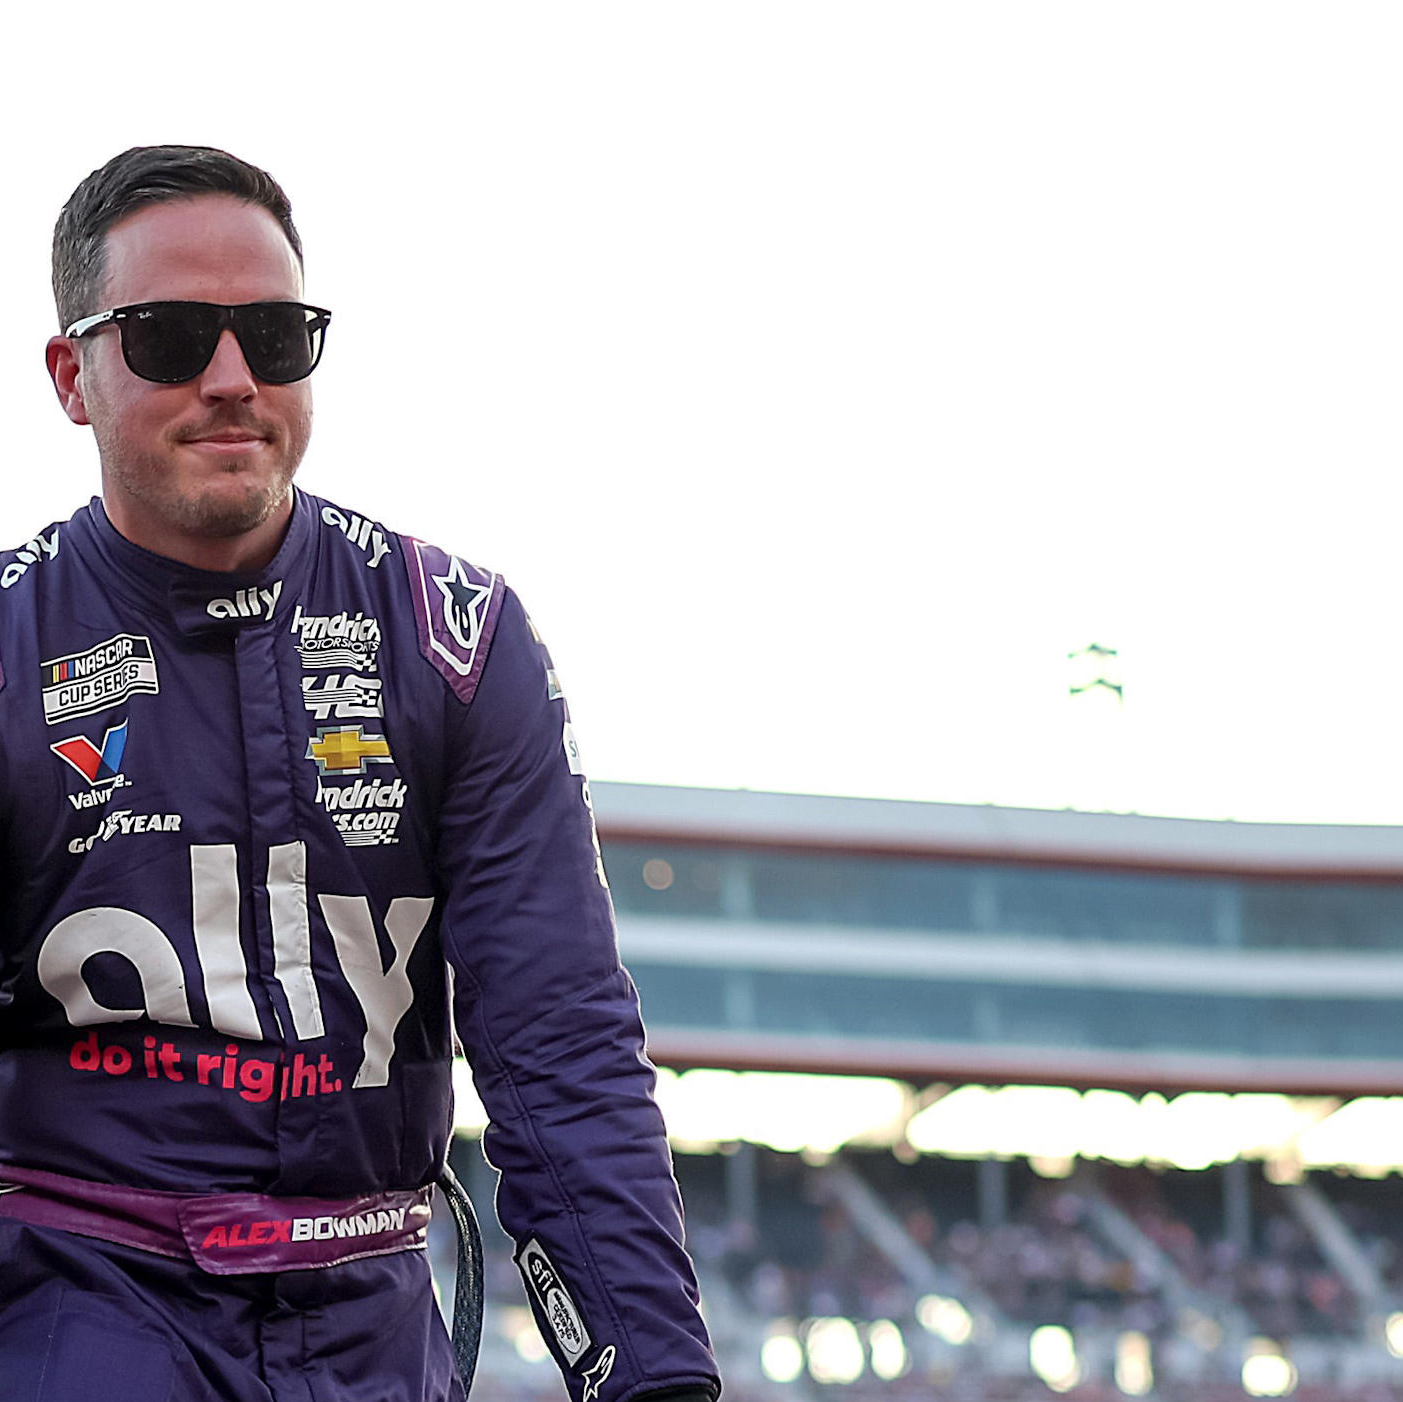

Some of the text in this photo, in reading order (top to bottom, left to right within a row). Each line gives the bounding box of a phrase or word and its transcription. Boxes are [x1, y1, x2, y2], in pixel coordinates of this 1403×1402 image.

[321, 506, 392, 568] ally
[206, 580, 283, 621] ally
[75, 639, 133, 678] NASCAR
[59, 664, 140, 707] CUP SERES
[37, 840, 436, 1089] ally
[69, 1033, 343, 1102] do it right.
[531, 1258, 554, 1292] sfi
